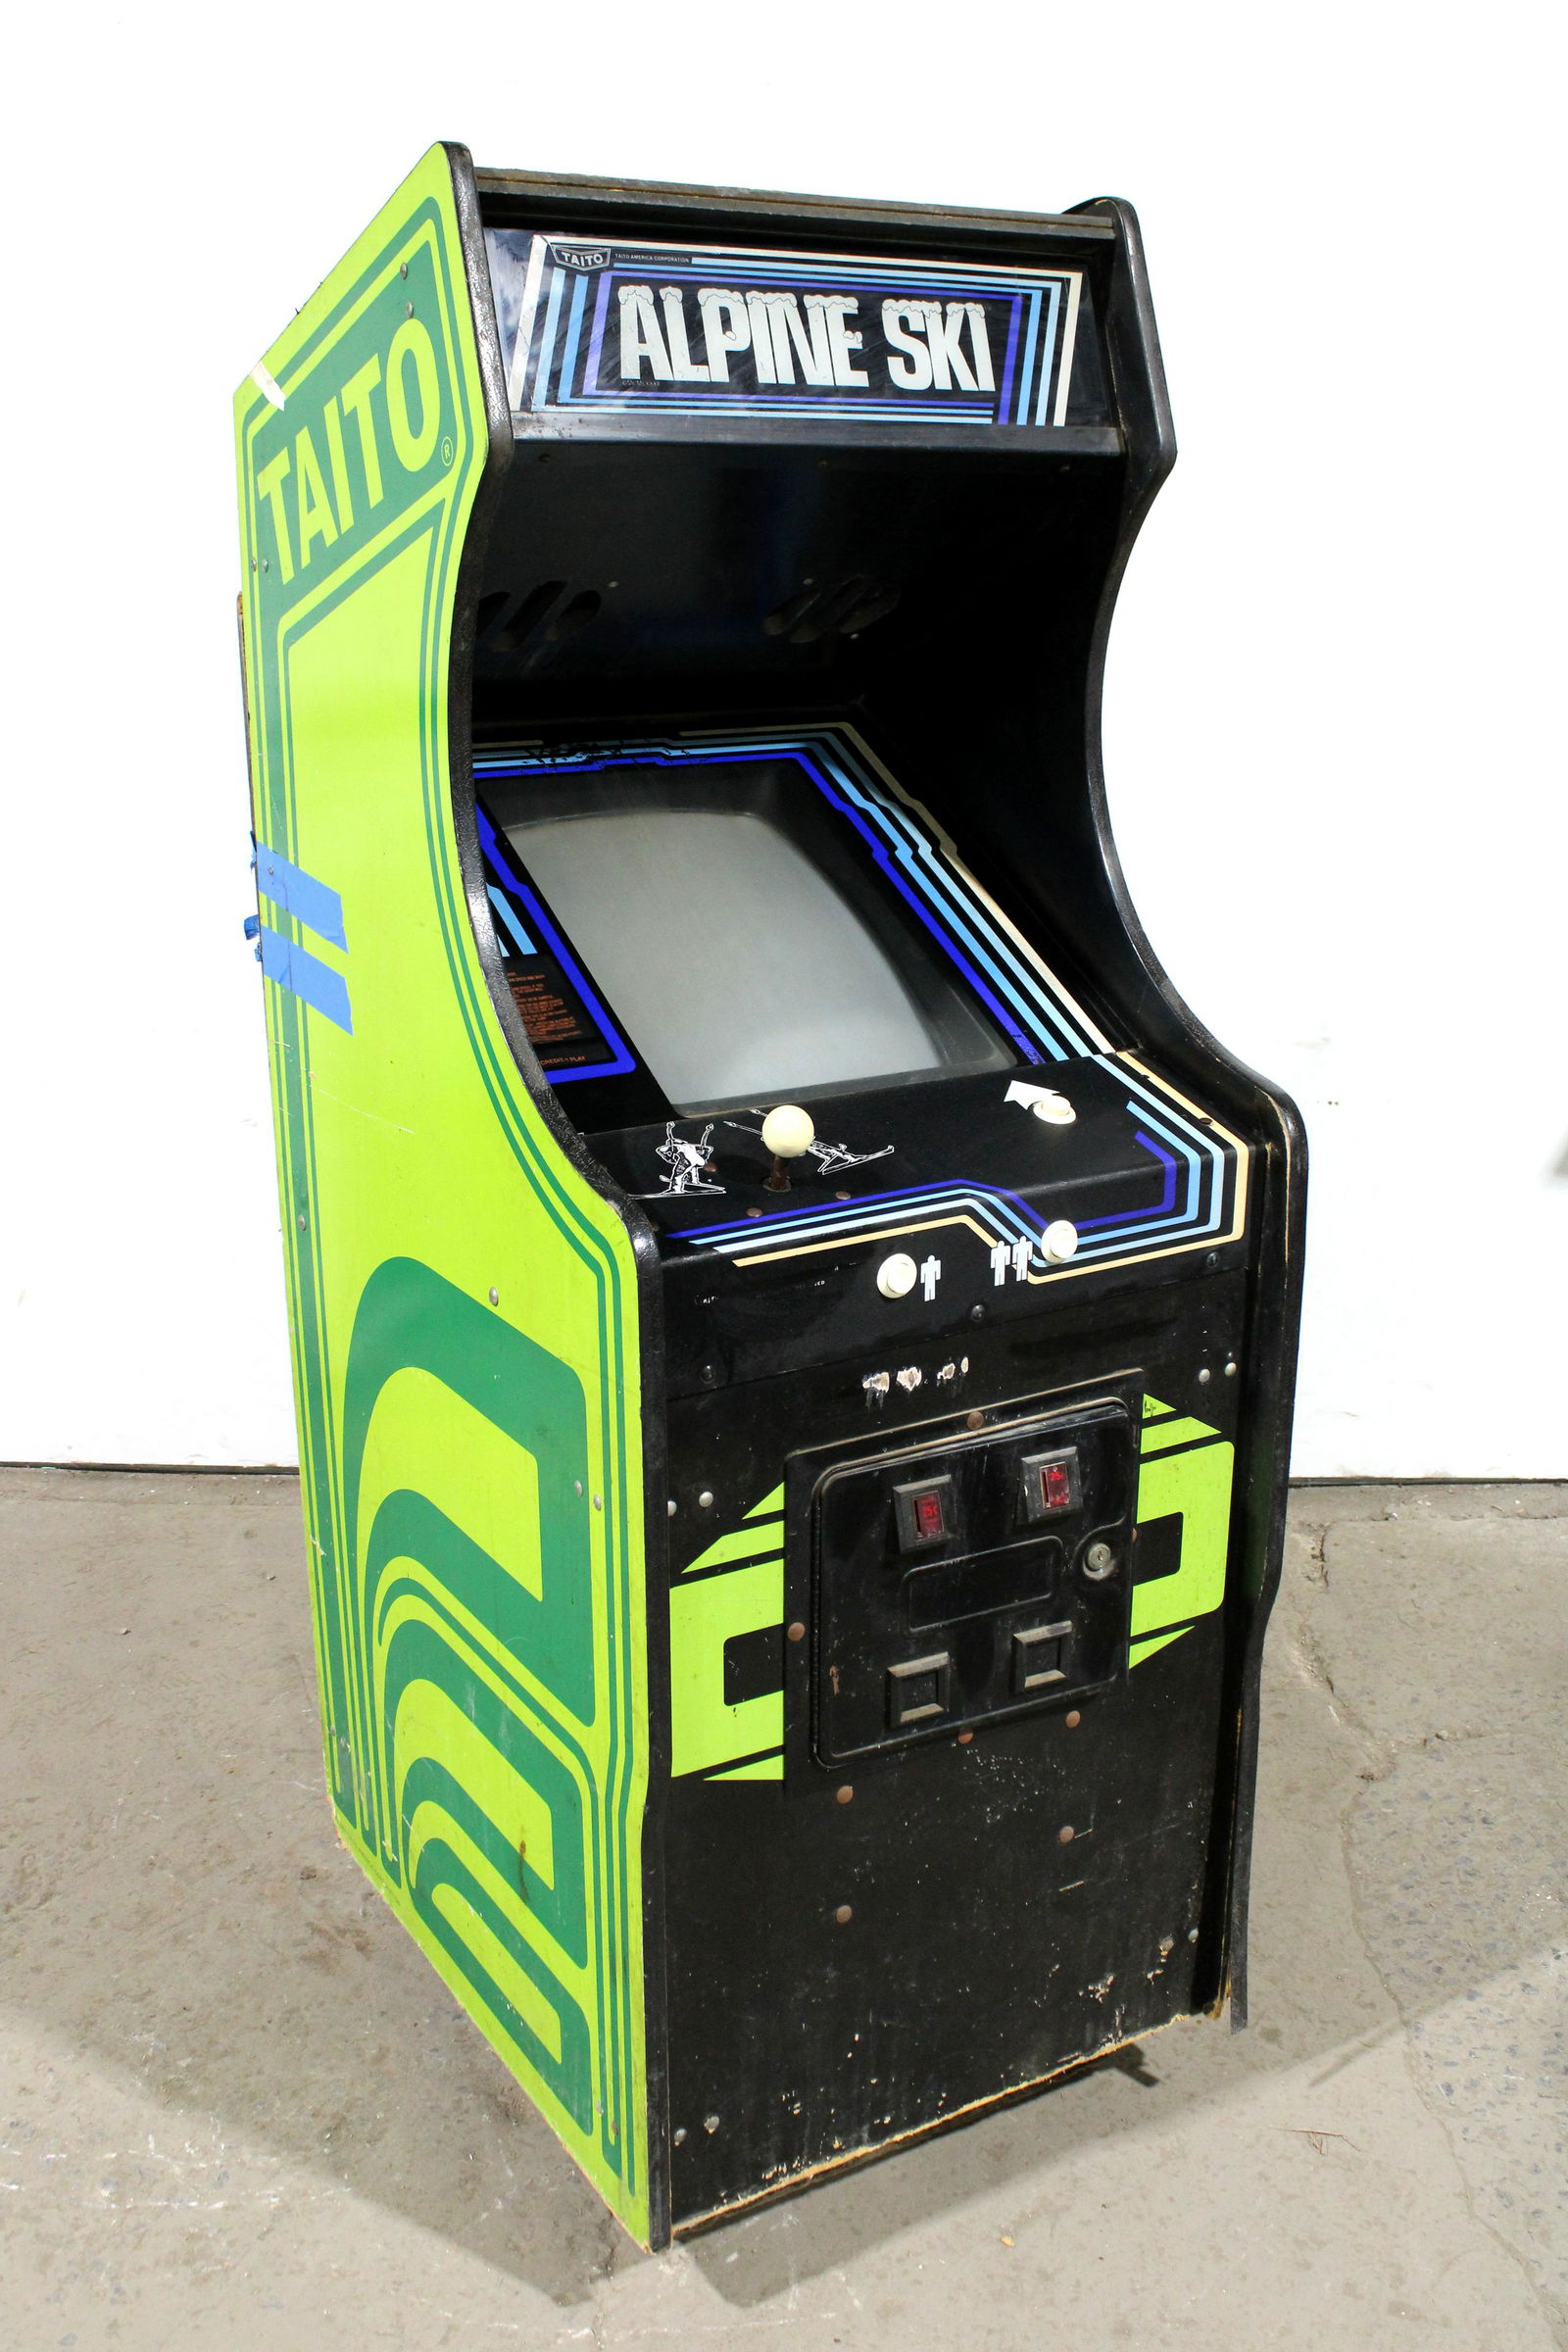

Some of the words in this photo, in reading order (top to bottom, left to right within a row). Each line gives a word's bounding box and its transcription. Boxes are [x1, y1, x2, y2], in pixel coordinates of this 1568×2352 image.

[562, 251, 604, 268] TAITO
[617, 285, 869, 388] ALPINE
[882, 299, 996, 392] SKI
[257, 318, 440, 586] TAITO
